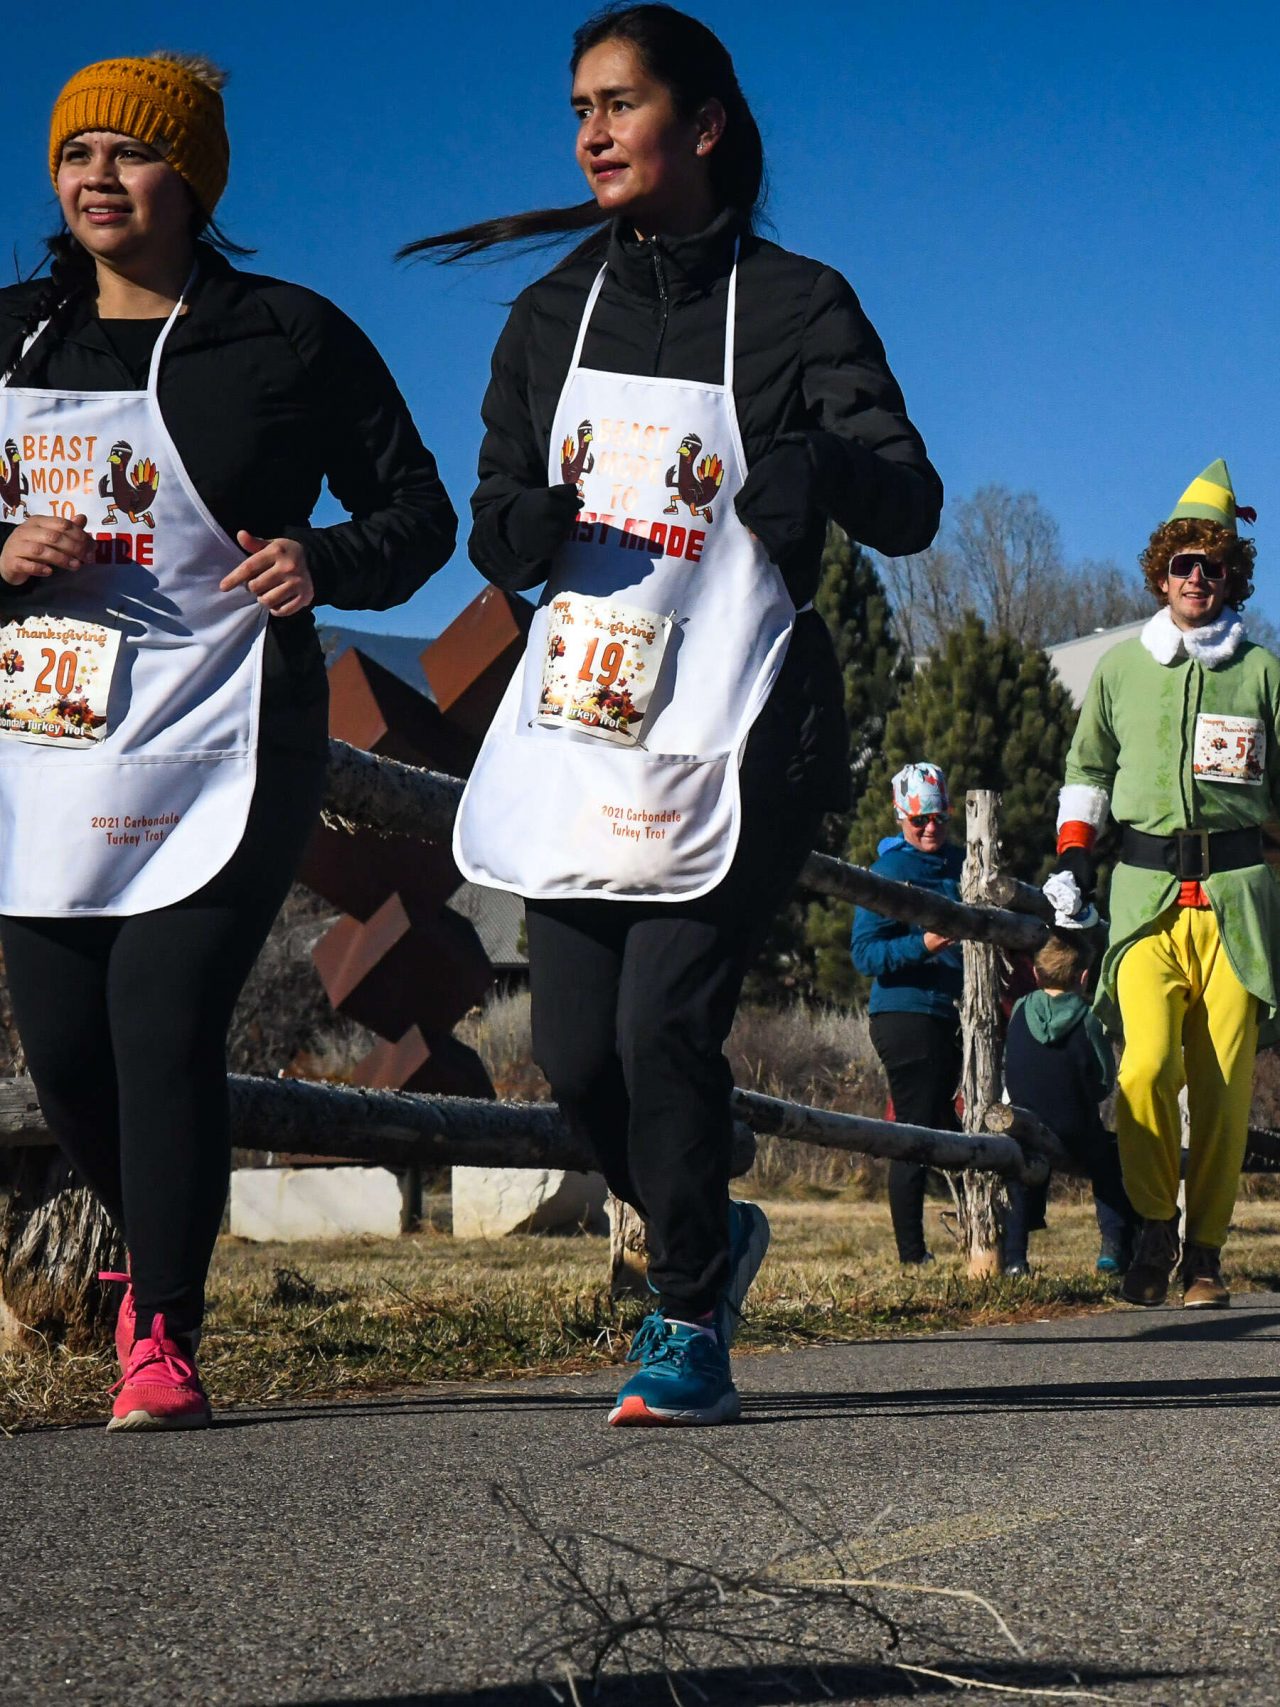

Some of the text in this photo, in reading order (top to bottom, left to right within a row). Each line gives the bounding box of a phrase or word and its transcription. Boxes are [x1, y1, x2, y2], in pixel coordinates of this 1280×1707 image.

[23, 435, 97, 462] BEAST
[31, 468, 94, 494] MODE
[610, 484, 639, 511] TO
[49, 500, 76, 521] TO
[91, 532, 154, 566] ODE
[619, 517, 706, 562] MODE
[16, 628, 107, 647] Thanksgiving
[34, 648, 78, 695] 20
[578, 637, 625, 686] 19
[27, 719, 61, 734] Turkey
[65, 722, 85, 736] Trot
[600, 714, 620, 728] Trot
[91, 812, 180, 828] 2021 Carbondale
[602, 805, 681, 822] 2021 Carbondale
[106, 830, 164, 847] Turkey Trot
[612, 822, 666, 842] Turkey Trot
